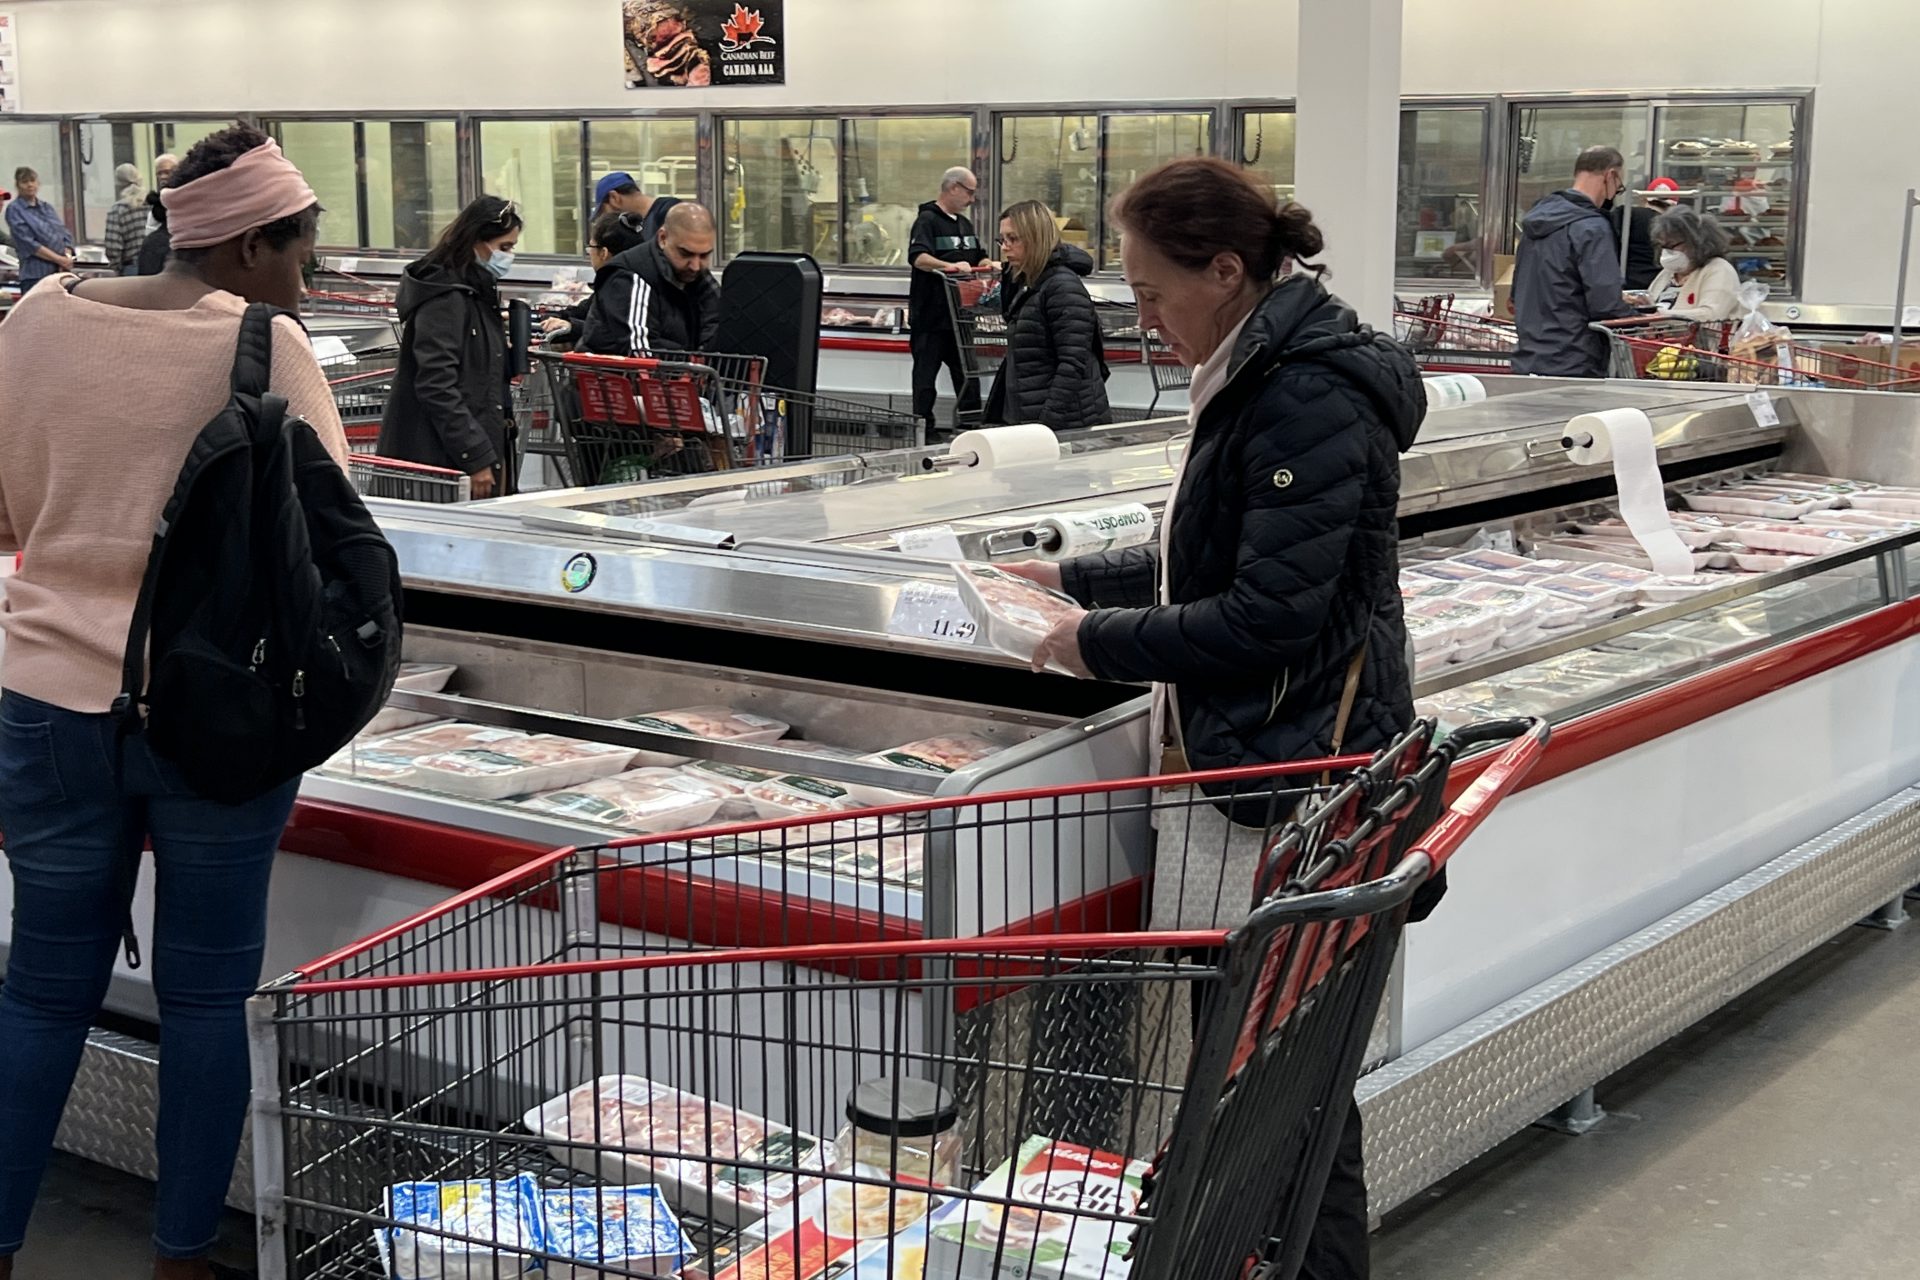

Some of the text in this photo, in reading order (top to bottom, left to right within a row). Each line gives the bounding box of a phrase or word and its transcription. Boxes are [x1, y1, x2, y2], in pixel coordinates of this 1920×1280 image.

[720, 51, 775, 60] CANADIAN BEEF
[723, 64, 774, 75] CANADA AAA
[932, 619, 976, 638] 11.49
